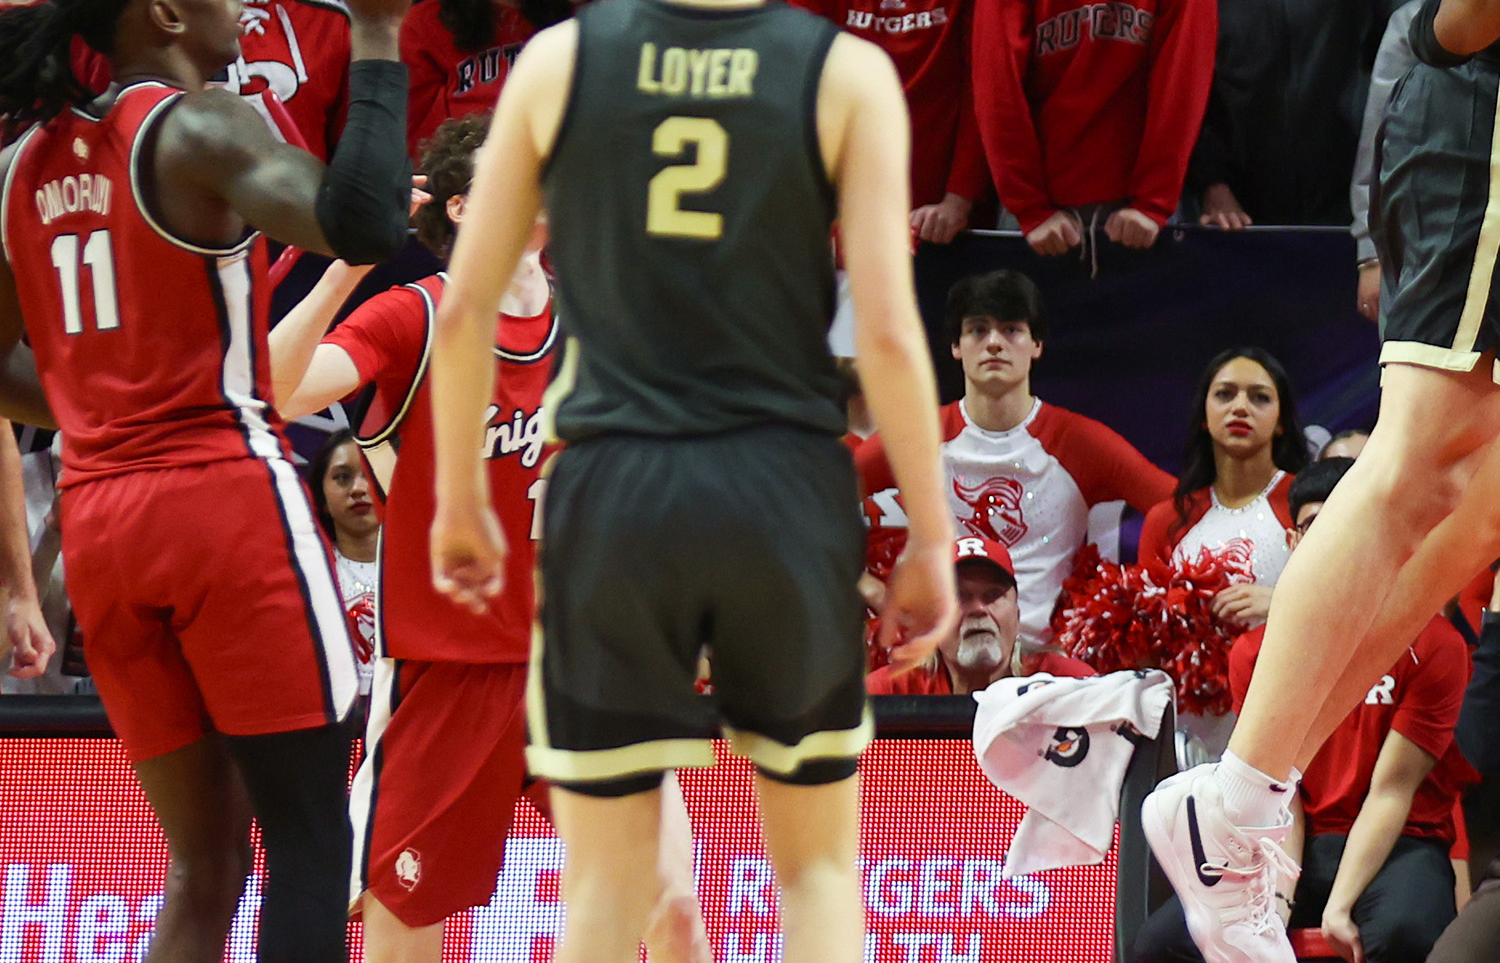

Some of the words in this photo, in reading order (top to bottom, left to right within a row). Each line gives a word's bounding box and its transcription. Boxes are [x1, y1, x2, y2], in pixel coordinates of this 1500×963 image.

[638, 42, 758, 98] LOYER
[646, 115, 730, 238] 2
[51, 230, 120, 335] 11
[956, 537, 989, 558] R
